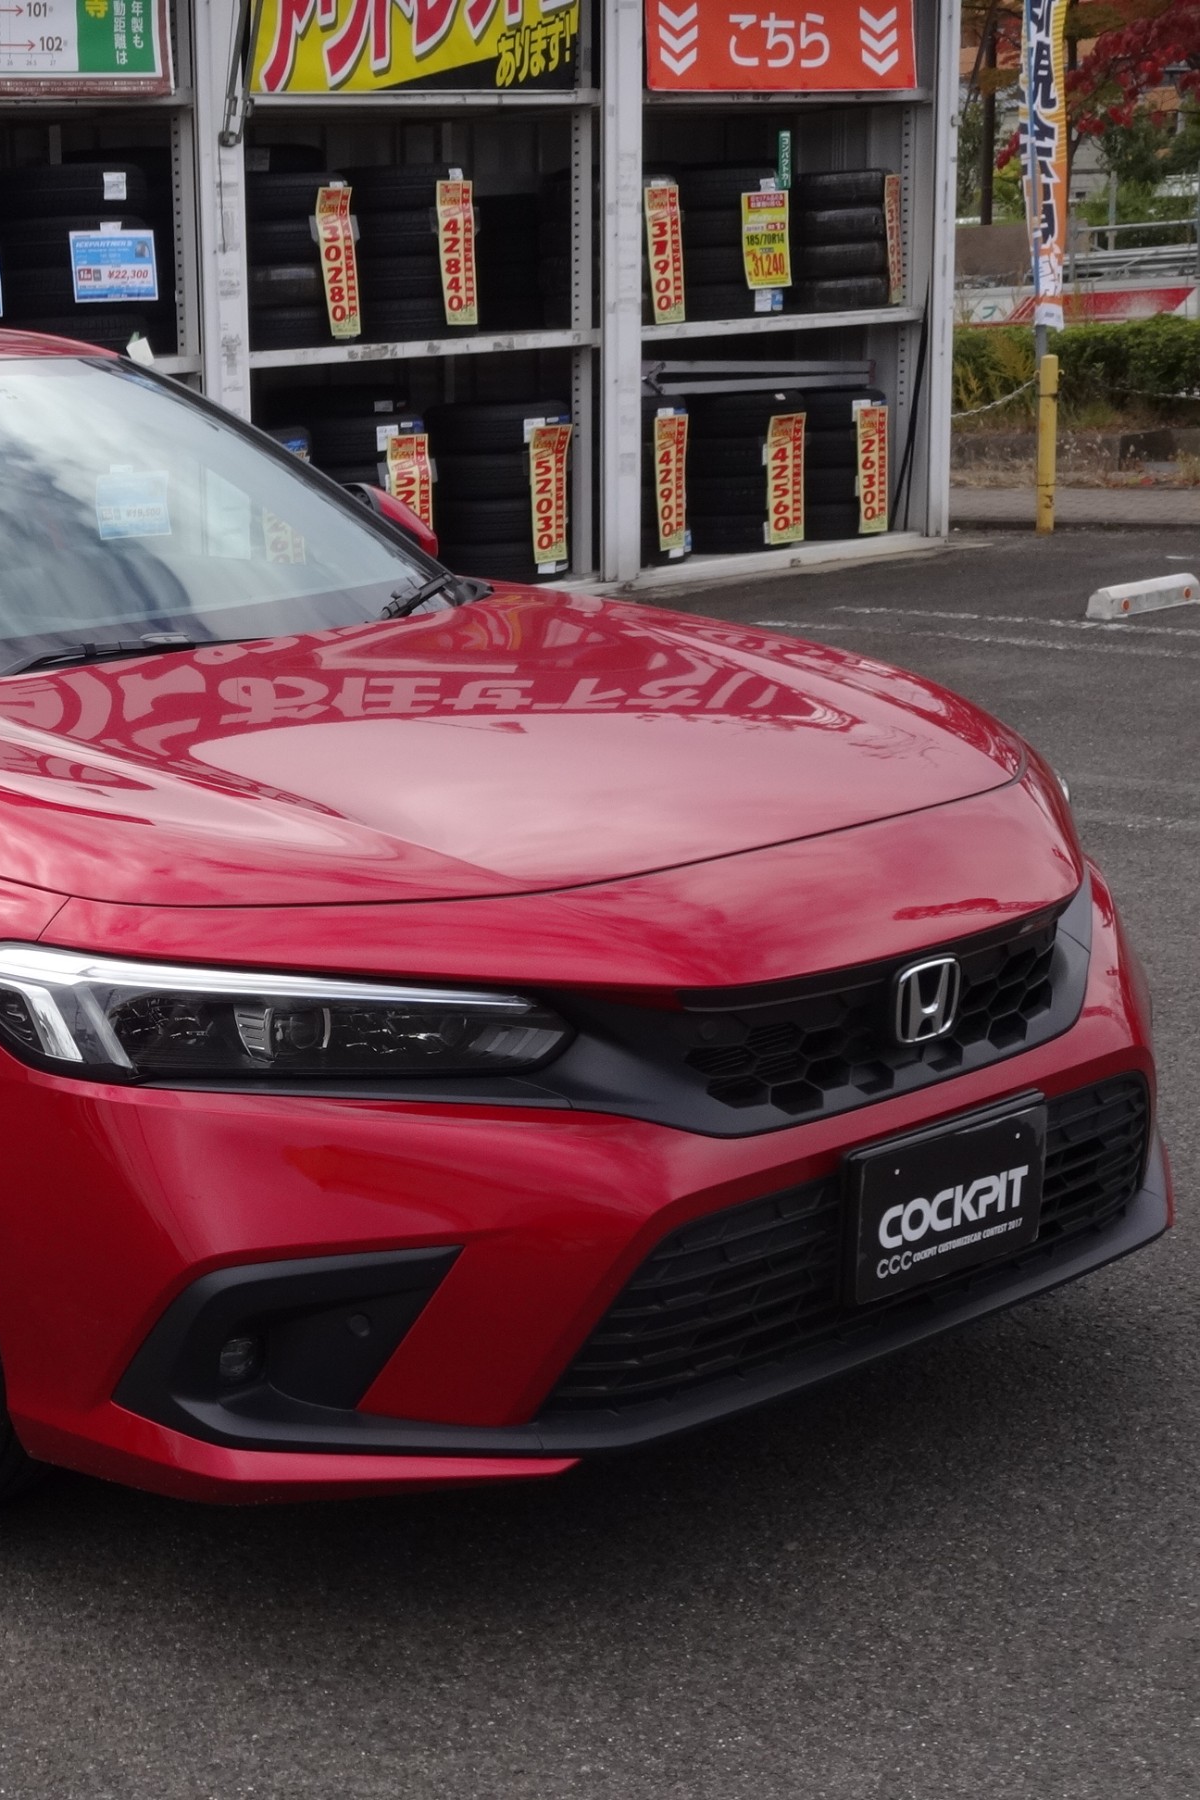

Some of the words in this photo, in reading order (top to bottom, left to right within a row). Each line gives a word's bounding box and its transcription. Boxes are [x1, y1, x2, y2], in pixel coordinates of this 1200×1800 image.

[26, 2, 47, 17] 101
[40, 36, 63, 51] 102
[729, 12, 831, 68] こちら
[878, 1164, 1029, 1249] COCKPIT
[876, 1250, 913, 1279] CCC
